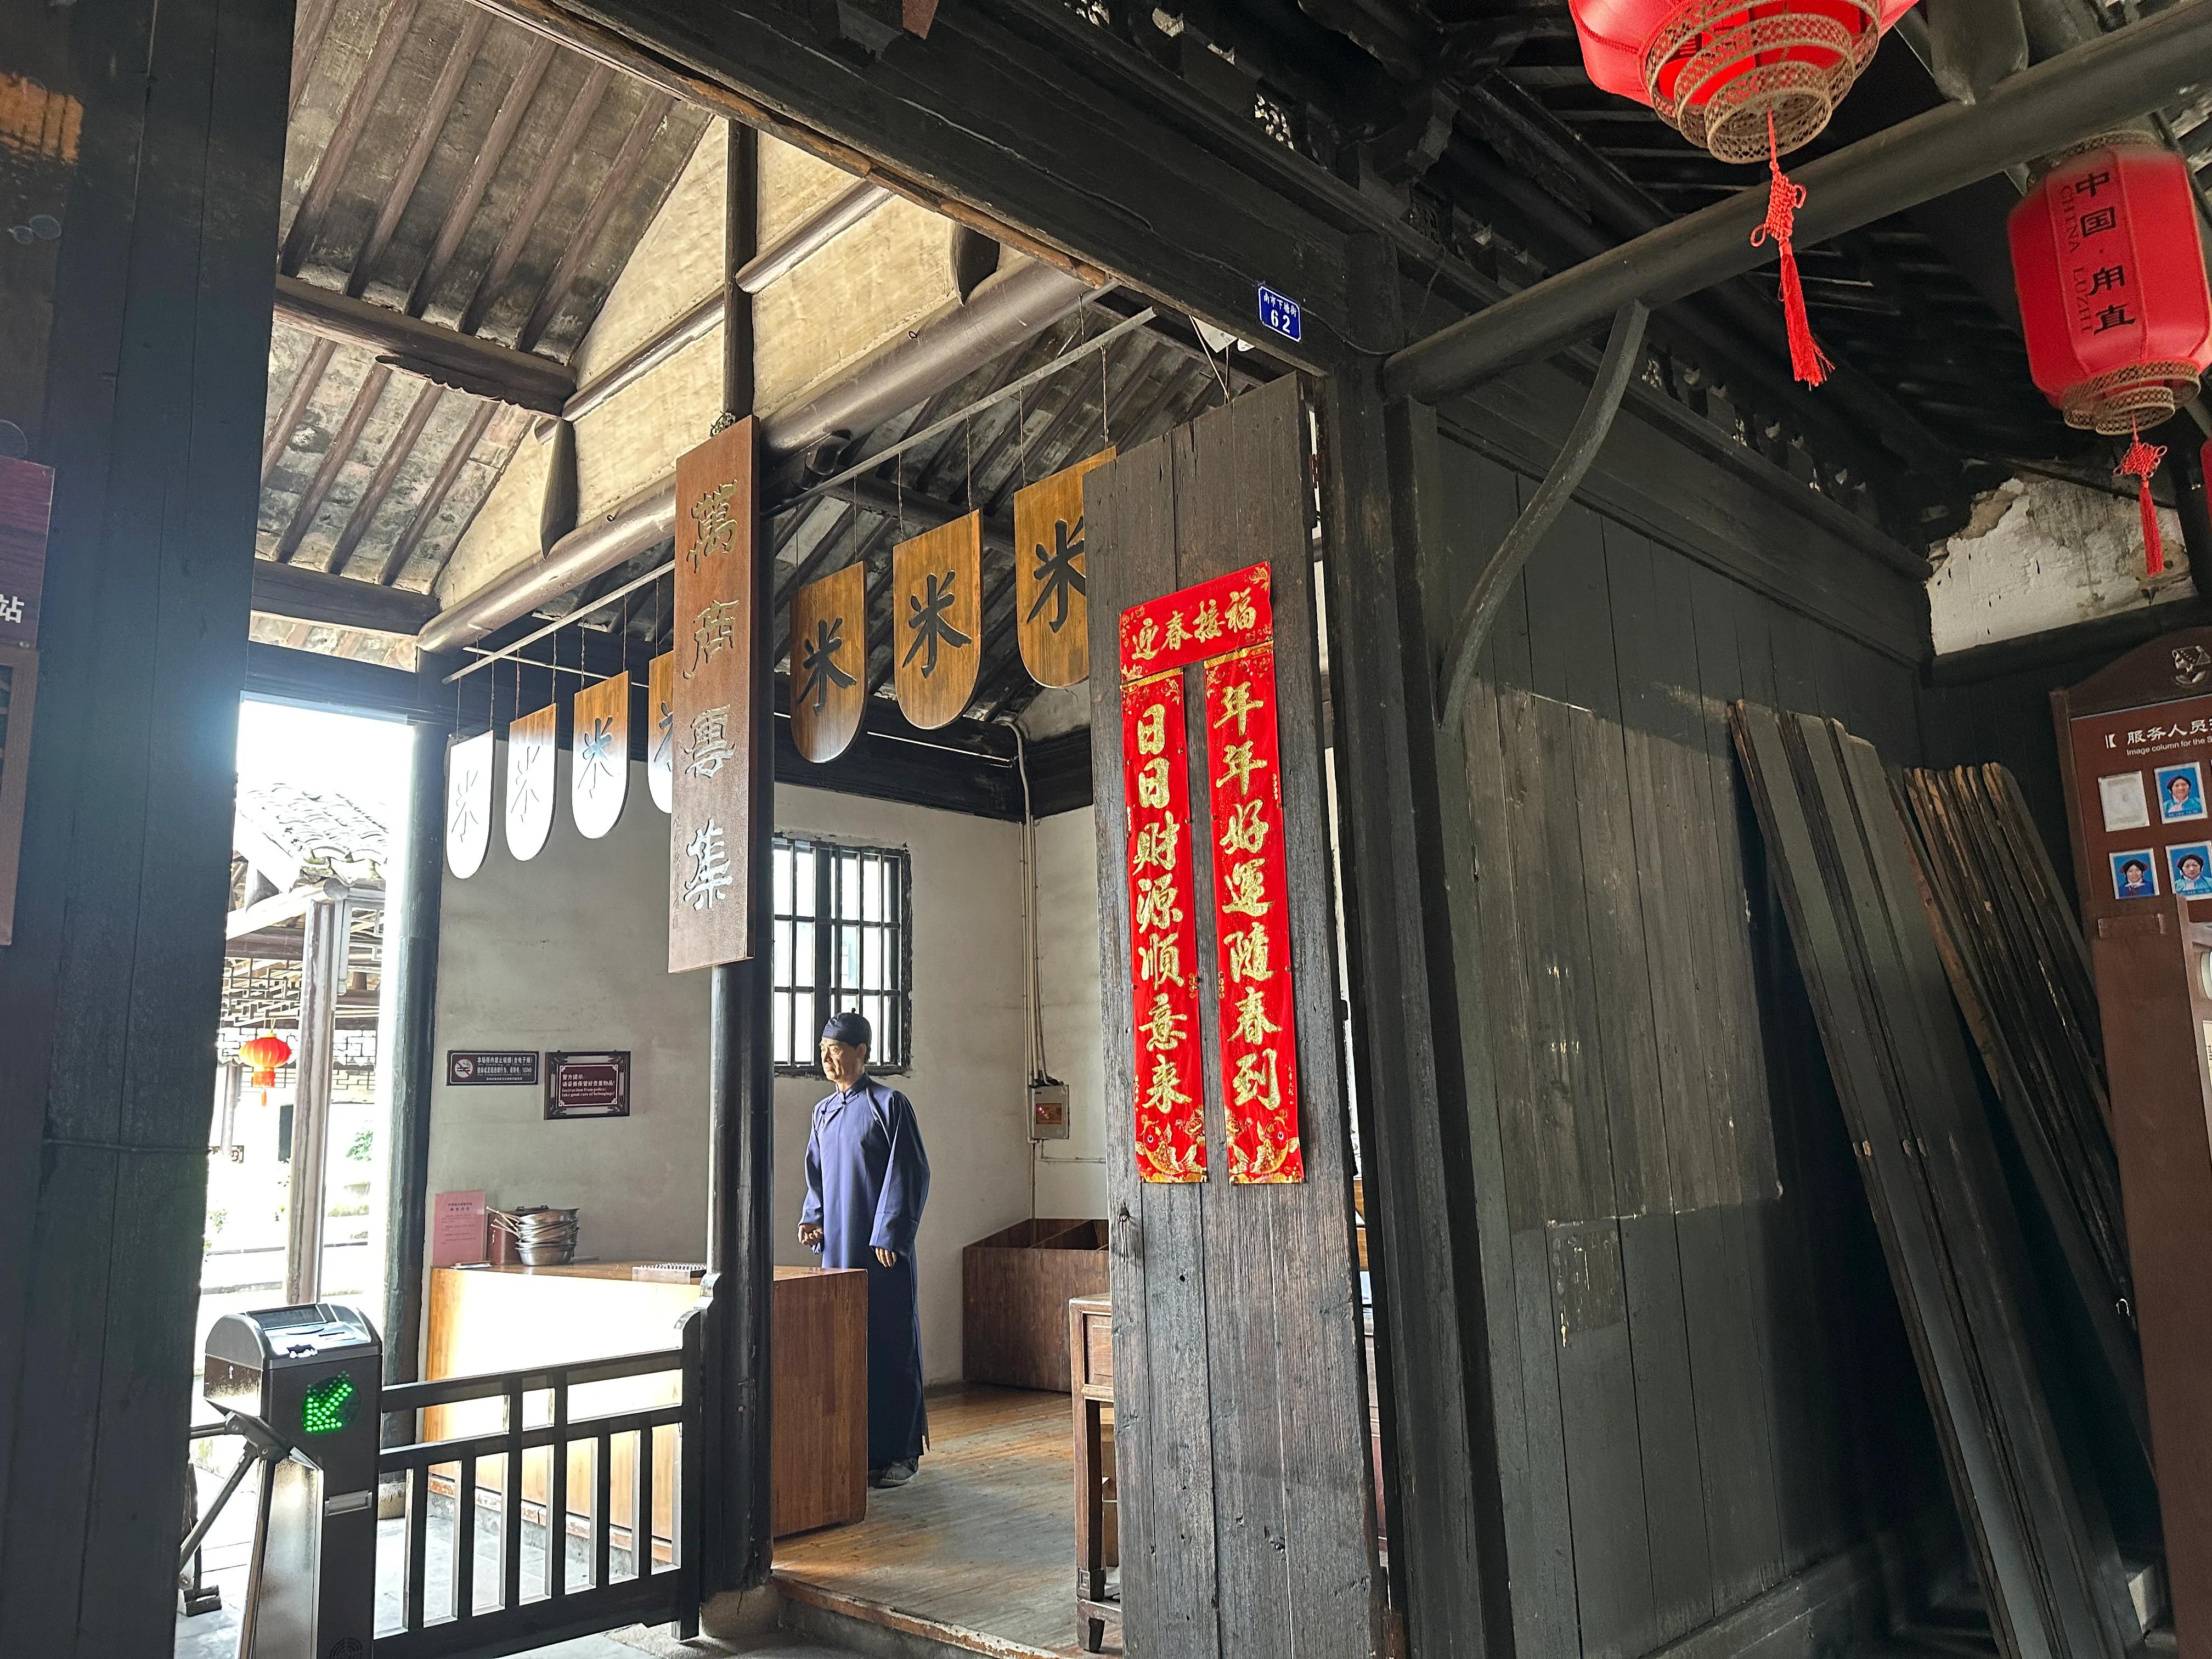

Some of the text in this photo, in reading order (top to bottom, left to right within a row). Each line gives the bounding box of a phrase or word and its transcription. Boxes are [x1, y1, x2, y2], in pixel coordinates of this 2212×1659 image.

[2061, 184, 2093, 335] CHINA LUZHI
[1271, 309, 1290, 334] 62
[0, 594, 25, 624] 站
[1026, 515, 1086, 634] 米
[902, 569, 972, 679] 米
[1131, 587, 1257, 661] 迎春接福
[798, 617, 857, 716] 米
[578, 715, 620, 799] 米
[2126, 748, 2150, 756] Image
[2151, 742, 2180, 752] column
